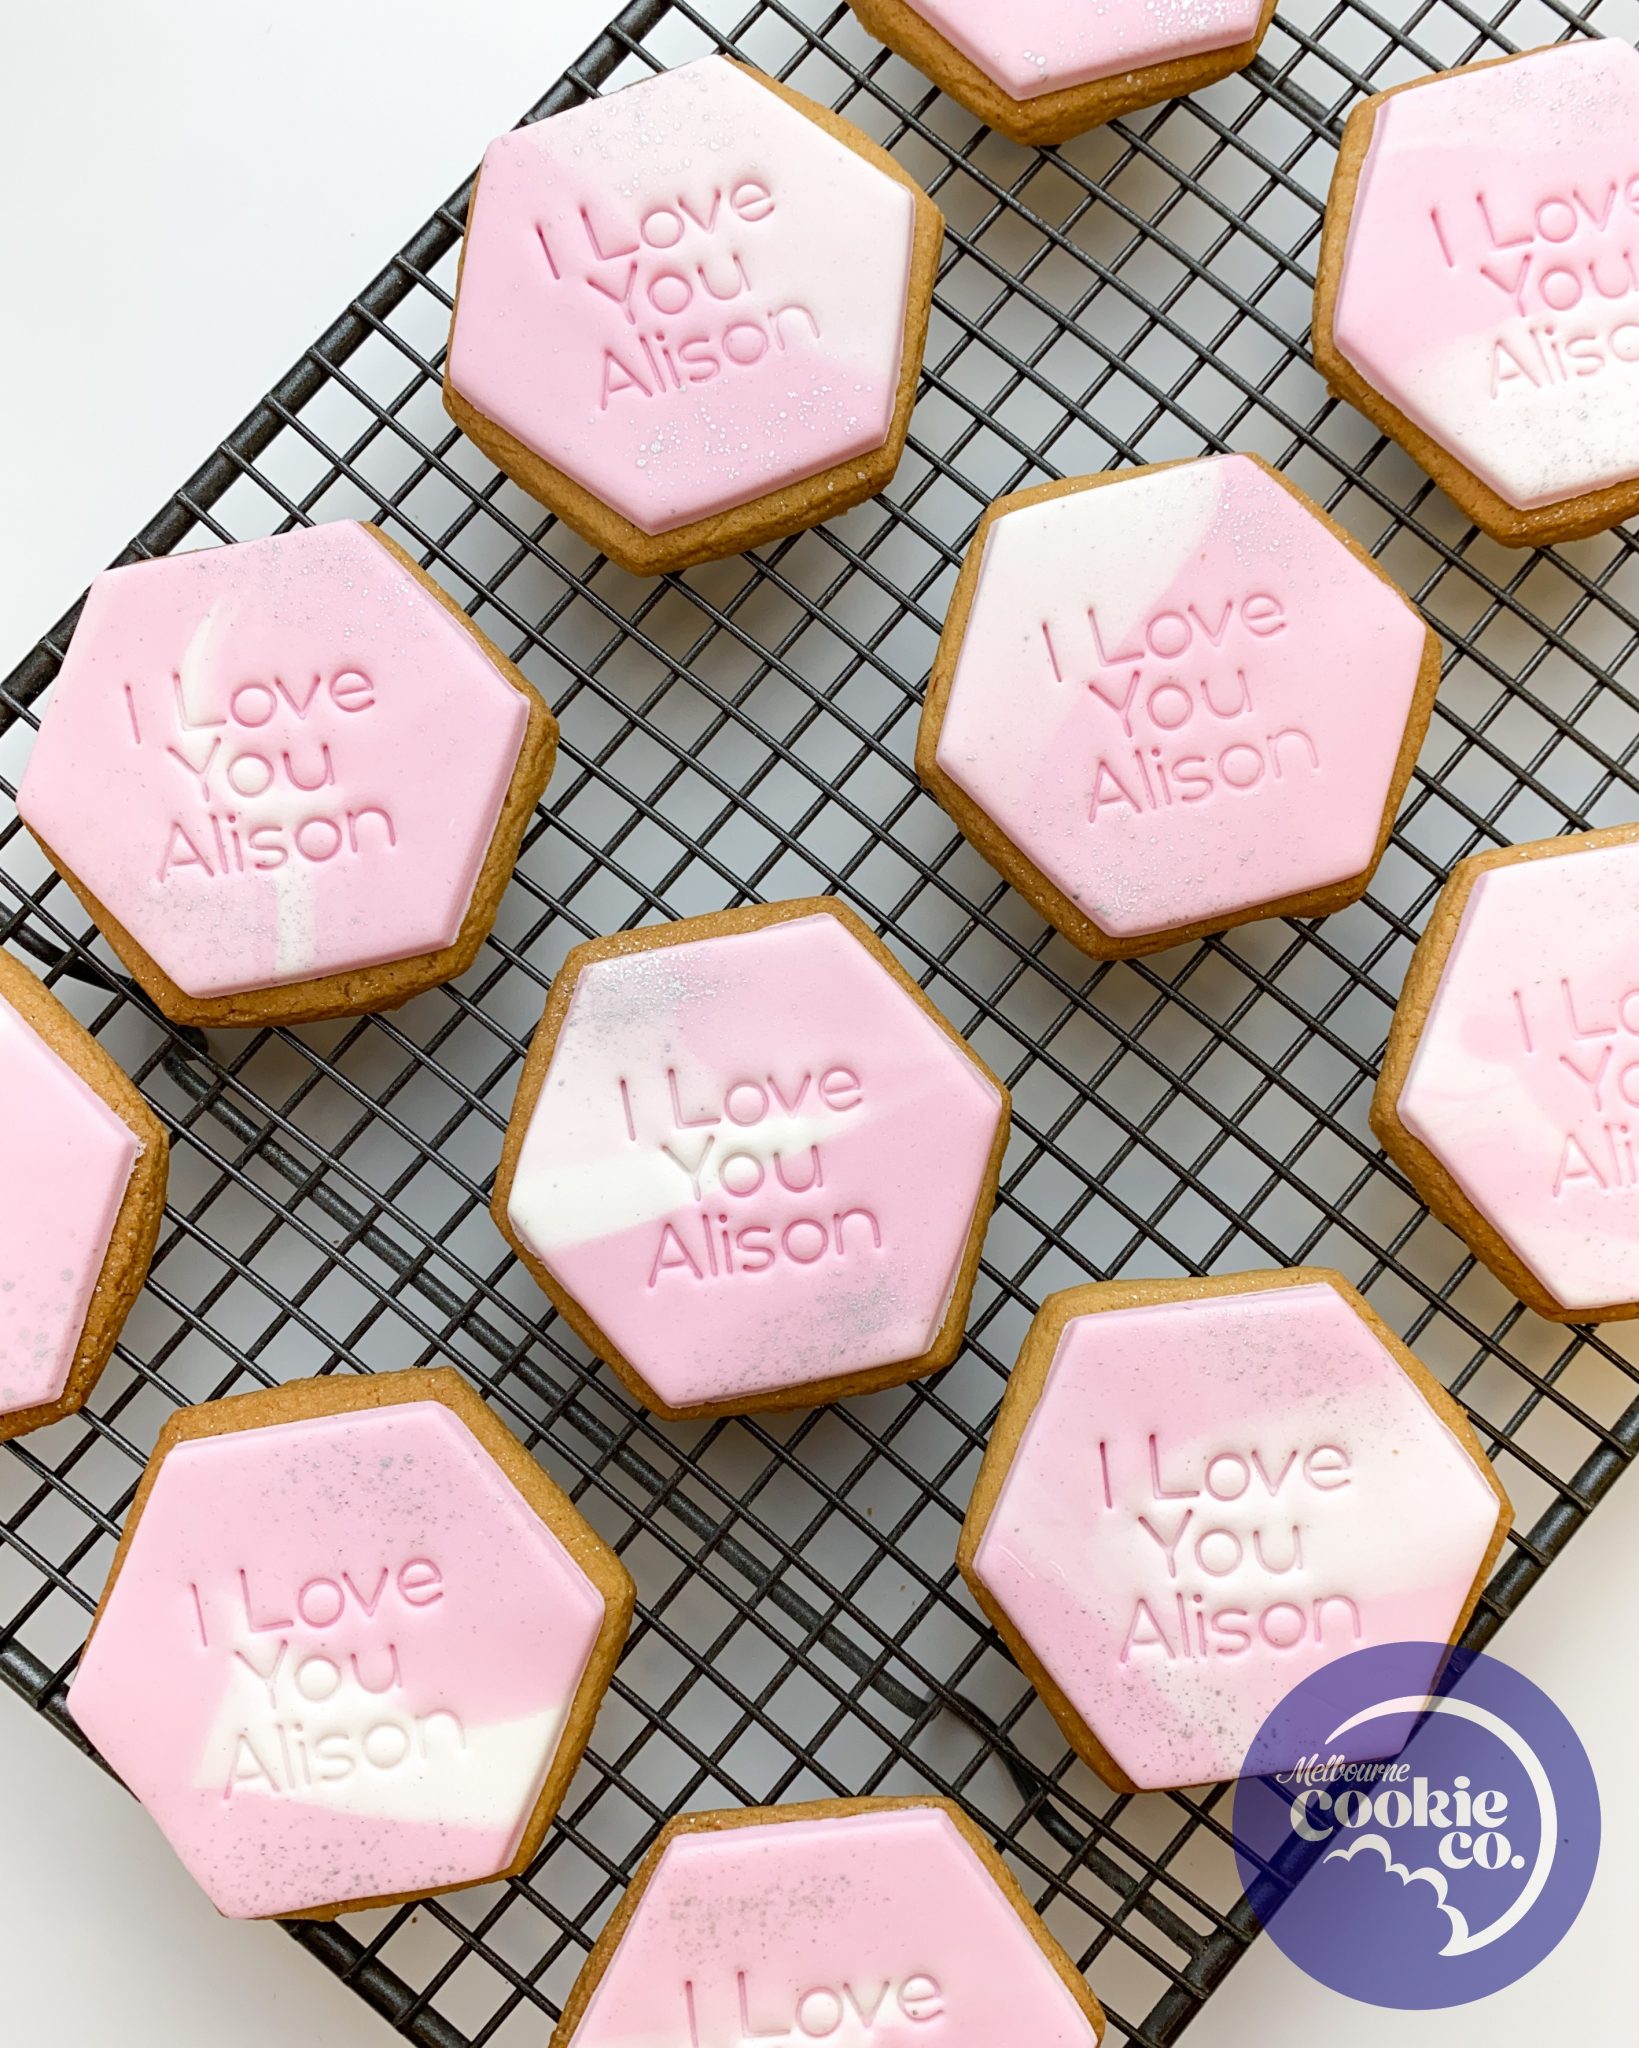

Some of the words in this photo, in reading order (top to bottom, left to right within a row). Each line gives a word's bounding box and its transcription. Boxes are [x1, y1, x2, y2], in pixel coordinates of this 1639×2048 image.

[536, 222, 560, 280] I
[580, 178, 775, 261] Love
[1431, 208, 1454, 268] I
[586, 252, 752, 325] You
[1480, 249, 1639, 317] You
[601, 304, 820, 411] Alison
[1042, 621, 1062, 683] I
[1087, 593, 1286, 667] Love
[124, 682, 141, 744] I
[173, 667, 376, 731] Love
[1088, 668, 1253, 738] You
[167, 736, 336, 803] You
[1088, 728, 1320, 823] Alison
[158, 806, 397, 883] Alison
[1512, 990, 1533, 1053] I
[620, 1077, 637, 1141] I
[667, 1066, 863, 1130] Love
[662, 1135, 824, 1202] You
[648, 1207, 882, 1288] Alison
[1099, 1441, 1113, 1509] I
[1149, 1434, 1352, 1502] Love
[1138, 1508, 1303, 1579] You
[191, 1582, 208, 1647] I
[239, 1558, 444, 1633] Love
[1120, 1592, 1362, 1663] Alison
[234, 1639, 403, 1710] You
[223, 1708, 467, 1800] Alison
[685, 1980, 699, 2048] I
[737, 1971, 944, 2038] Love
